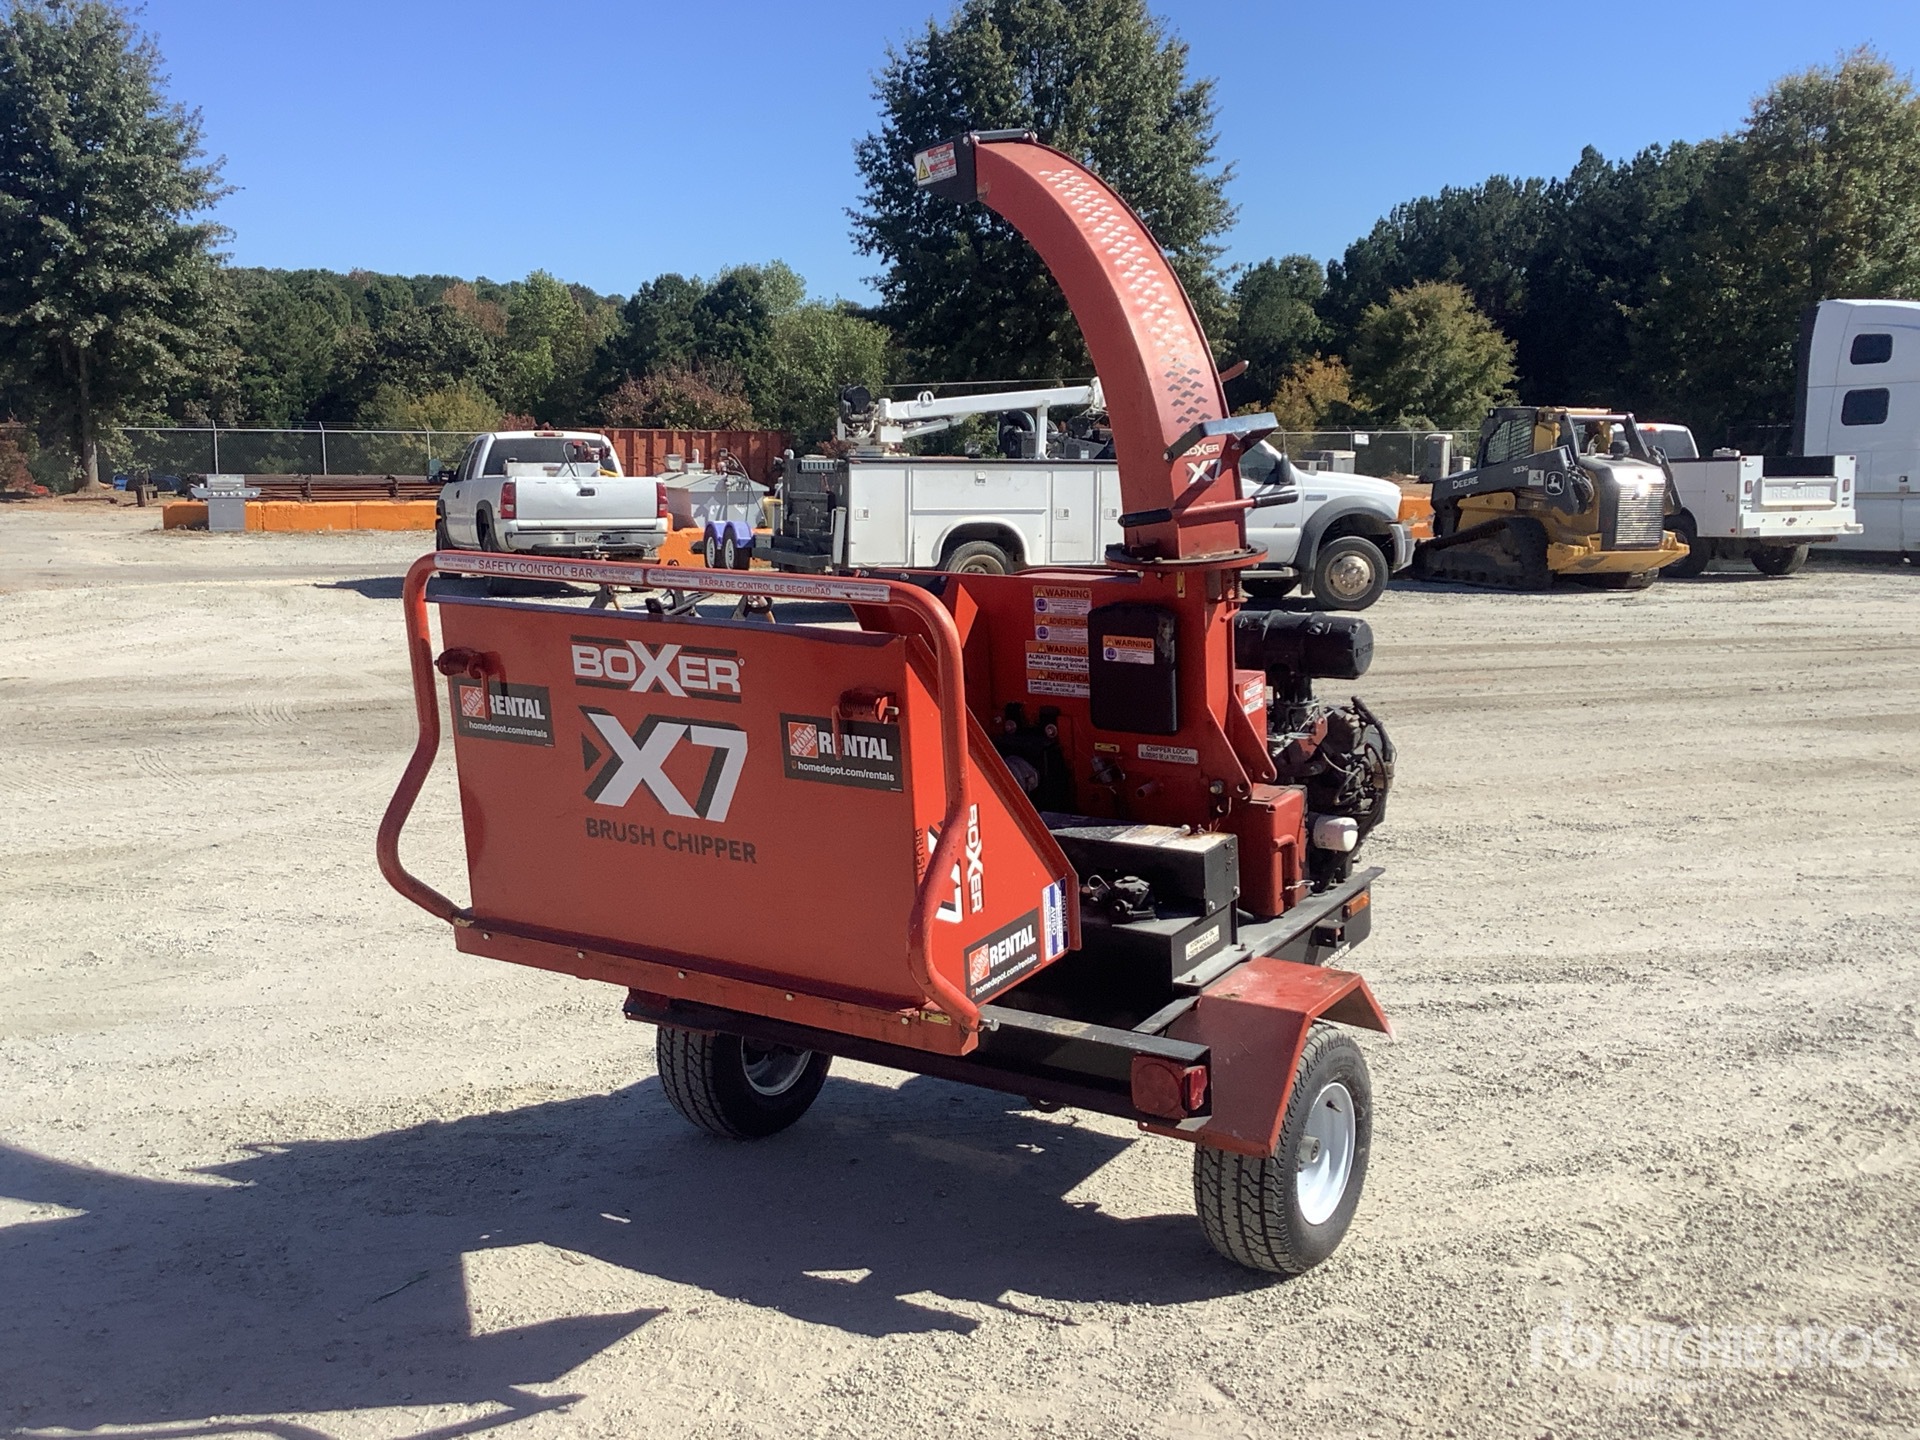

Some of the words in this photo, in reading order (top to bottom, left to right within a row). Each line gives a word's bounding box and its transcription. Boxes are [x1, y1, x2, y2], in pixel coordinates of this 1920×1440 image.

[1186, 458, 1222, 485] X7
[1452, 476, 1479, 490] DEERE
[1772, 487, 1825, 499] READING
[478, 559, 516, 573] SAFETY
[519, 563, 567, 577] CONTROL
[570, 567, 593, 578] BAR
[698, 578, 725, 588] BARRA
[737, 581, 773, 591] CONTROL
[774, 584, 785, 592] DE
[786, 584, 832, 596] SEGURIDAD
[1045, 588, 1090, 598] WARNING
[1045, 645, 1087, 655] WARNING
[1115, 639, 1153, 648] WARNING
[571, 639, 742, 698] BOXER
[489, 694, 546, 720] RENTAL
[468, 721, 548, 738] homedepot.com/rentals
[790, 724, 817, 756] HOME
[1146, 746, 1171, 754] CHIPPER
[586, 712, 749, 823] X7
[798, 761, 895, 782] homedepot.com/rentals
[585, 818, 656, 847] BRUSH
[662, 829, 758, 864] CHIPPER
[915, 828, 926, 877] BRUSH
[966, 803, 984, 914] BOXER
[990, 924, 1037, 968] RENTAL
[976, 953, 1038, 996] homedepot.com/rentals
